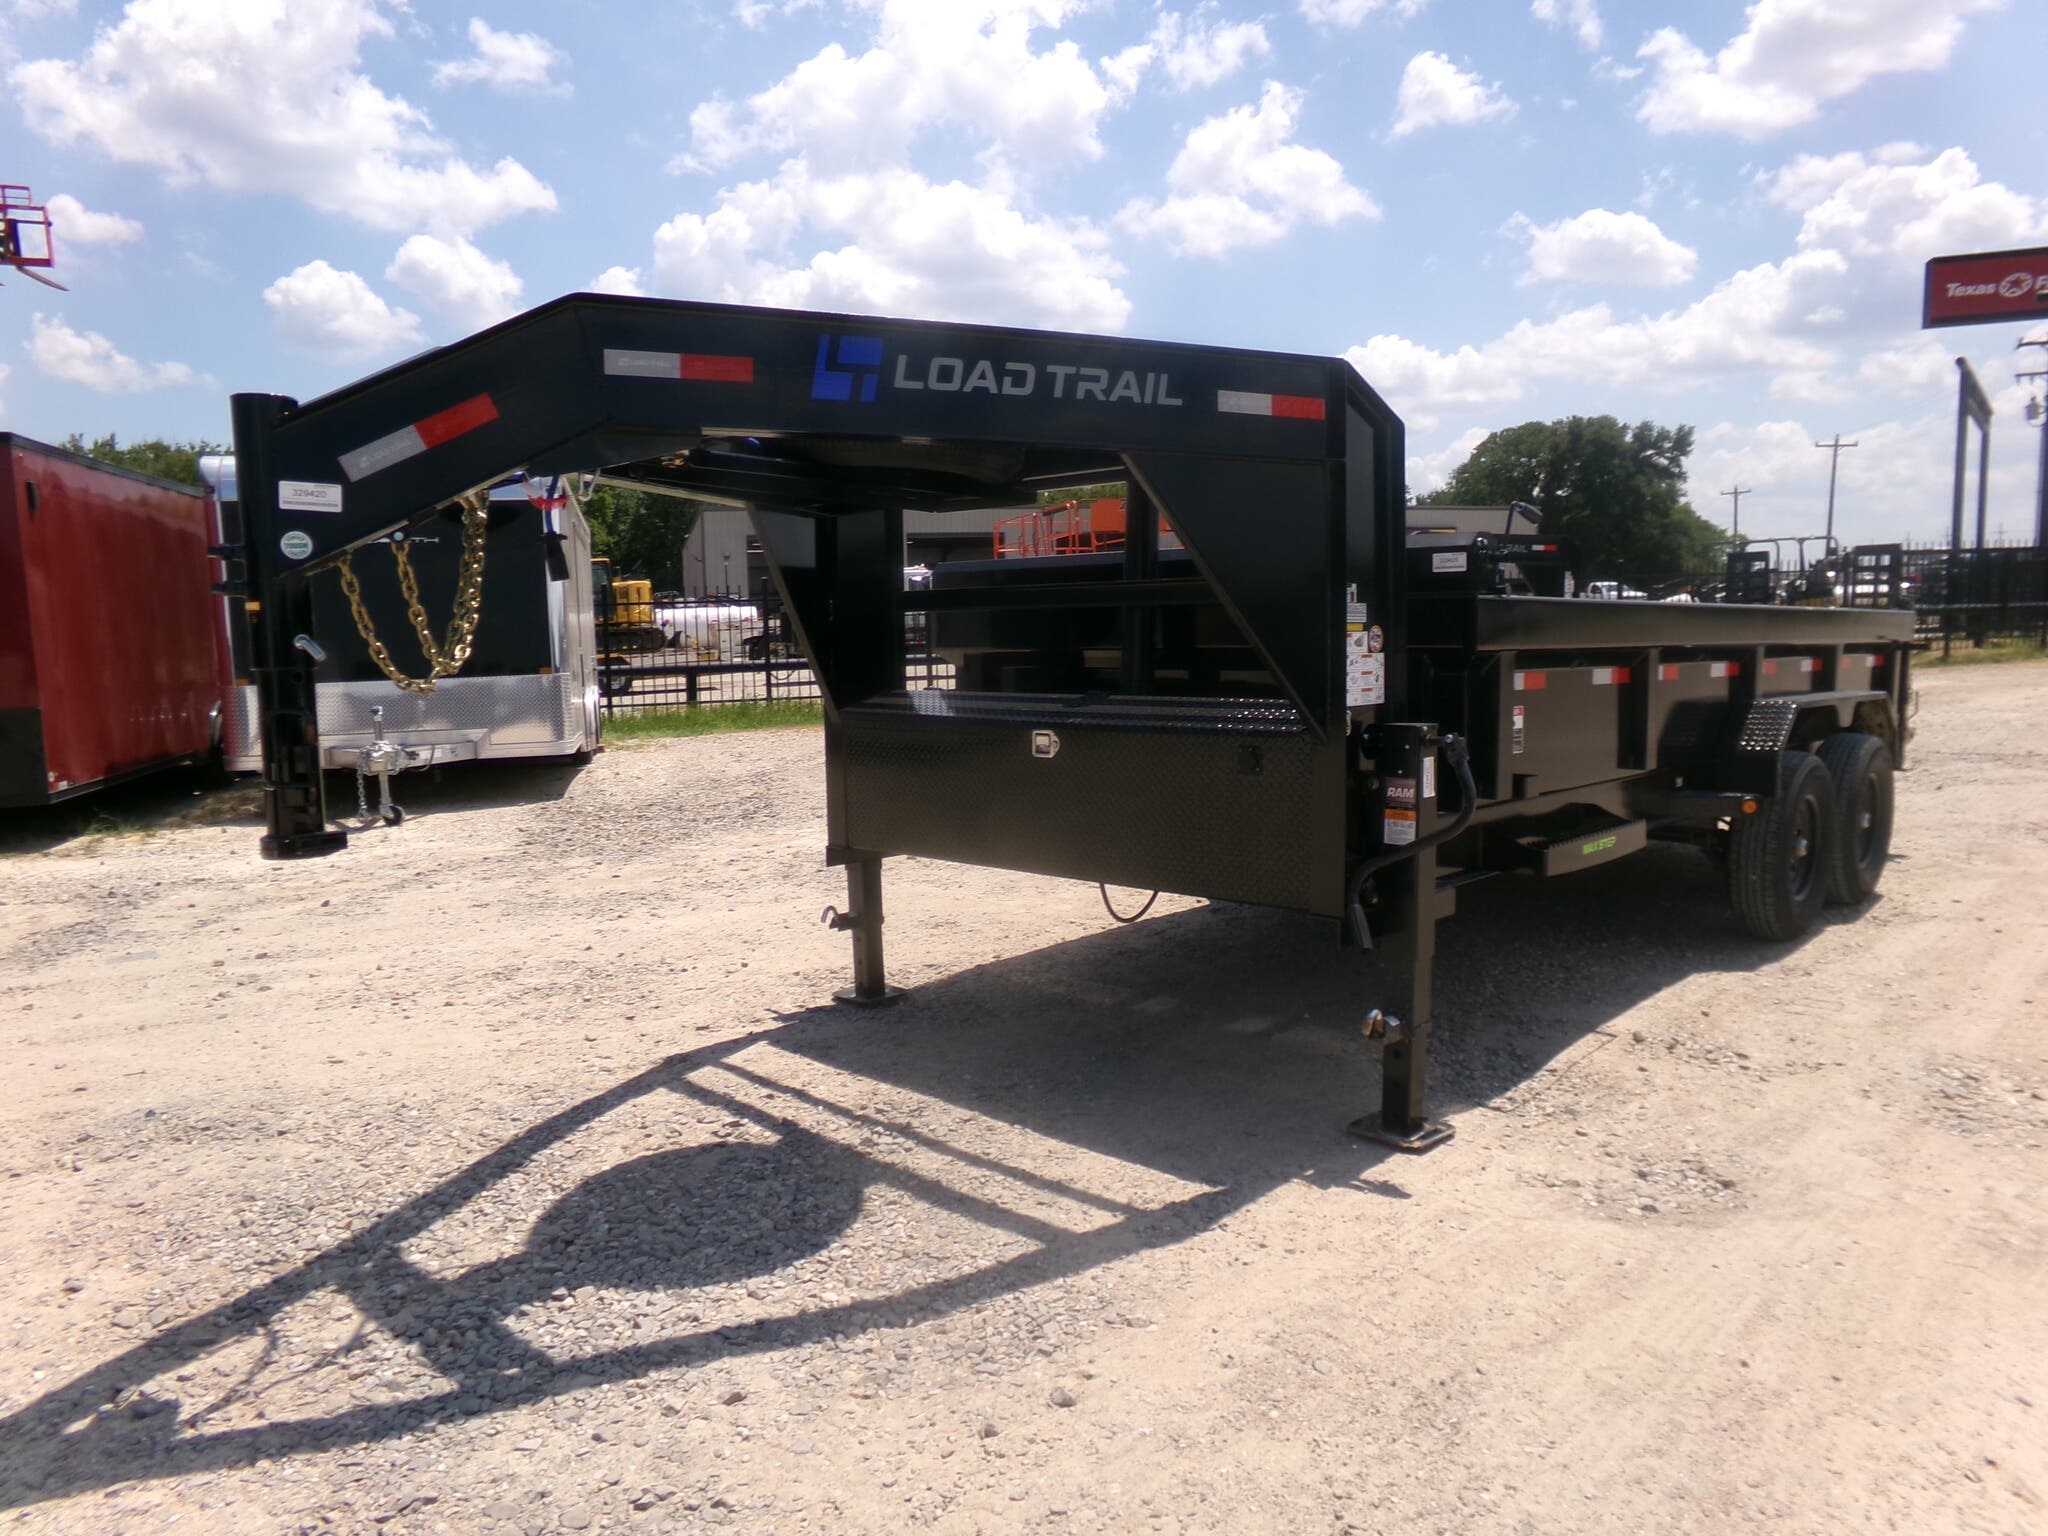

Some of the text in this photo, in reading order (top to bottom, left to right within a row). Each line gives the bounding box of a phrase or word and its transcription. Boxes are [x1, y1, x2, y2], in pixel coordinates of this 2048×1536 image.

[1945, 282, 1997, 297] Texas
[894, 354, 1036, 396] LOAD
[1046, 365, 1183, 406] TRAIL
[1386, 787, 1415, 798] RAM
